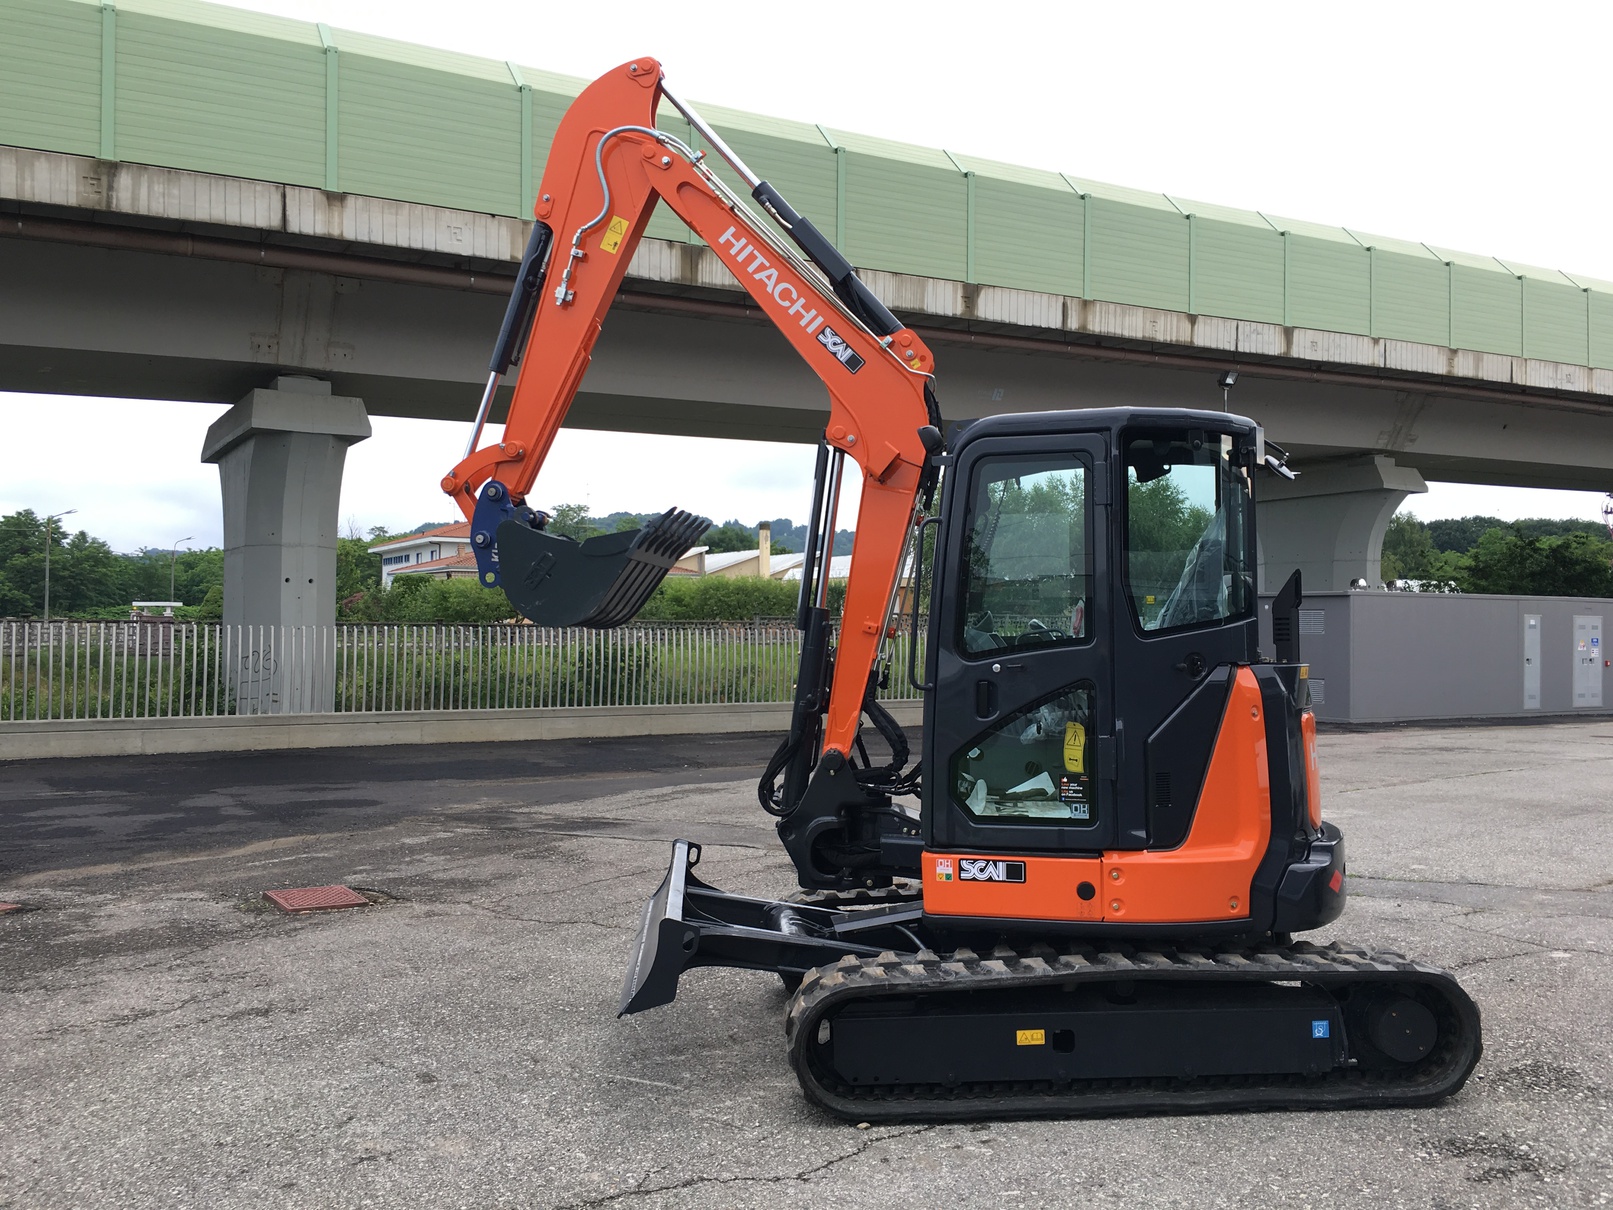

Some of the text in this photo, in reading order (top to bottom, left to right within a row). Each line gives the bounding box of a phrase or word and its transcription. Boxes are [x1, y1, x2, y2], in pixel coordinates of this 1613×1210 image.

[718, 226, 825, 334] HITACHI
[816, 326, 854, 363] SCAI
[960, 859, 1005, 882] SCAI
